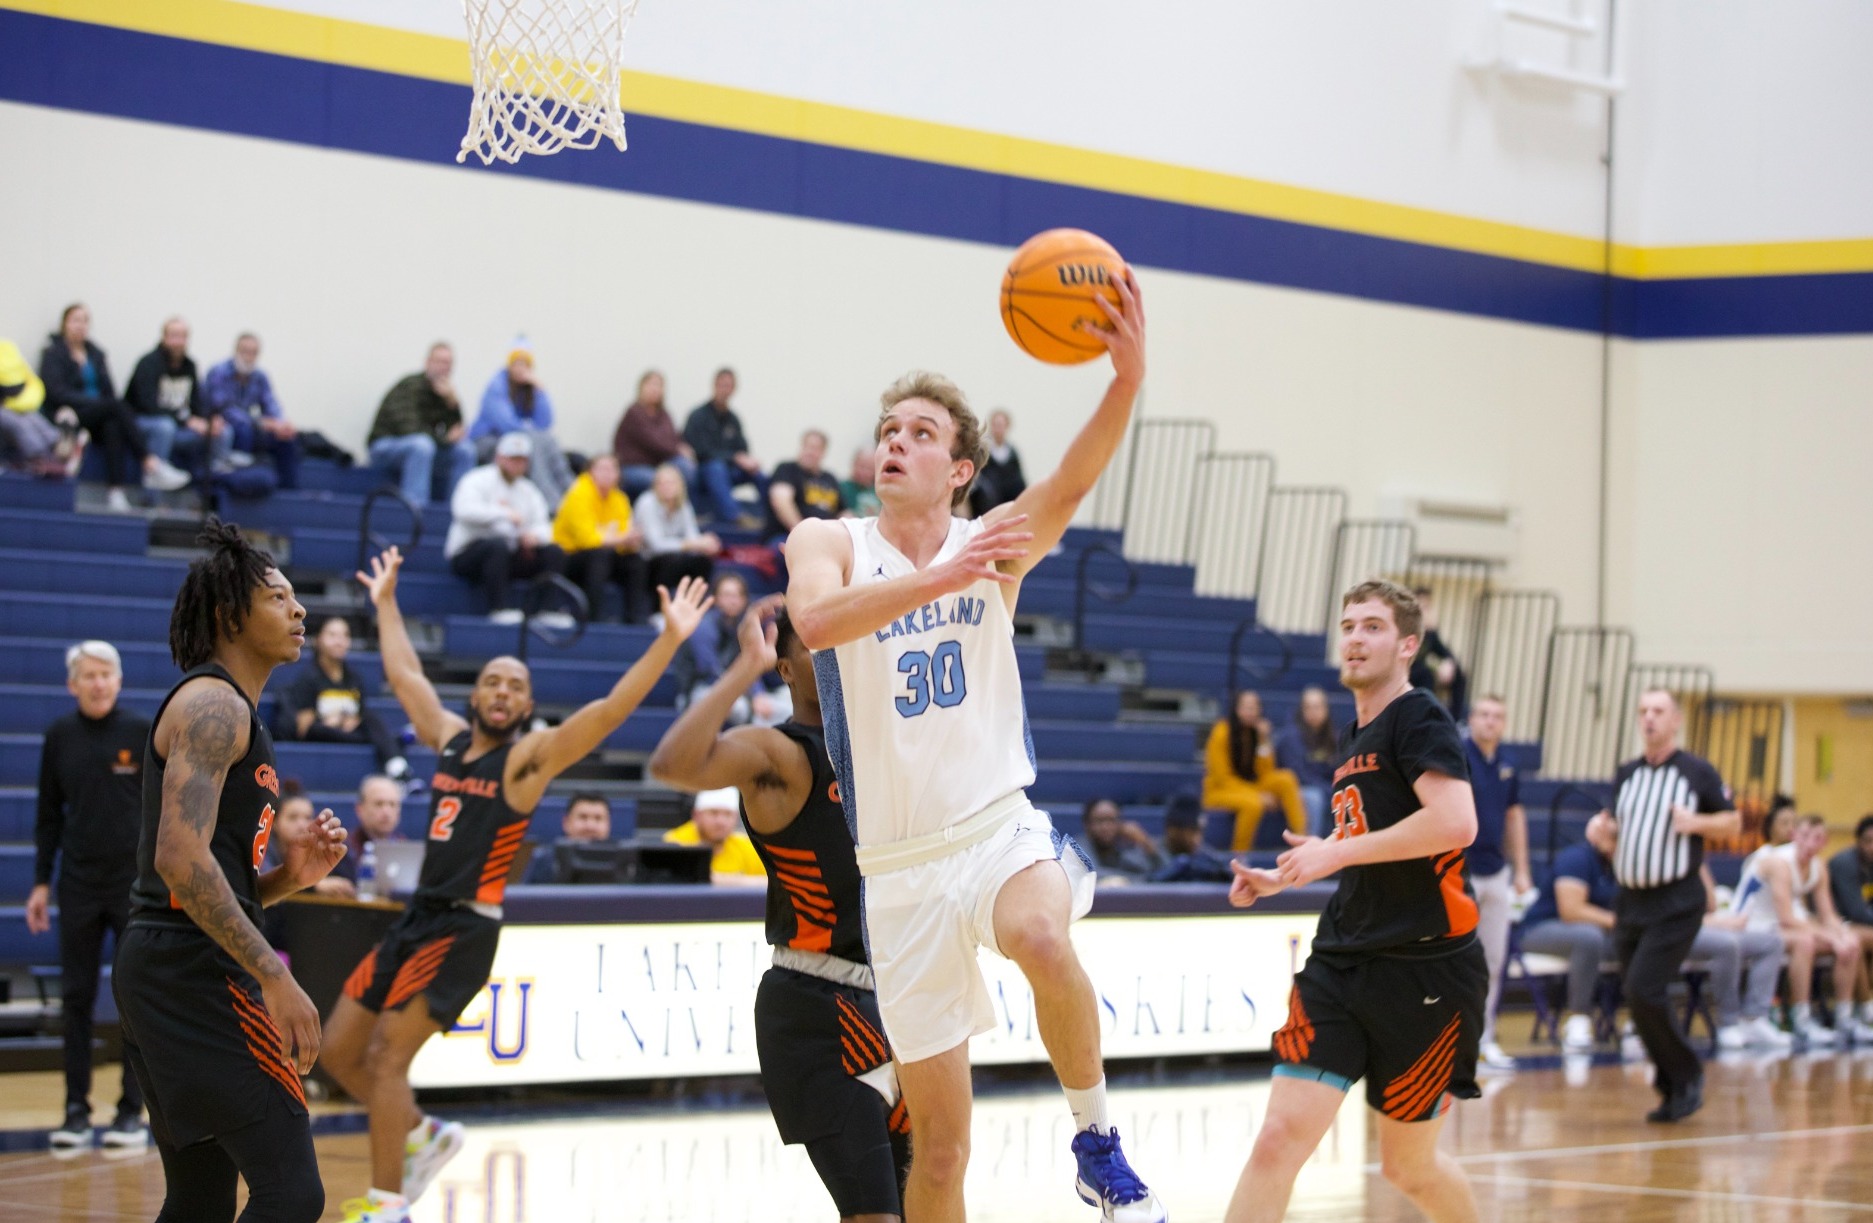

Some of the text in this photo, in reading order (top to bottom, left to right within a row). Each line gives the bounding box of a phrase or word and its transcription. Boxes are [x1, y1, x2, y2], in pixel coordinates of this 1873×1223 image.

[894, 639, 967, 719] 30
[430, 795, 462, 842] 2
[1330, 783, 1370, 841] 33
